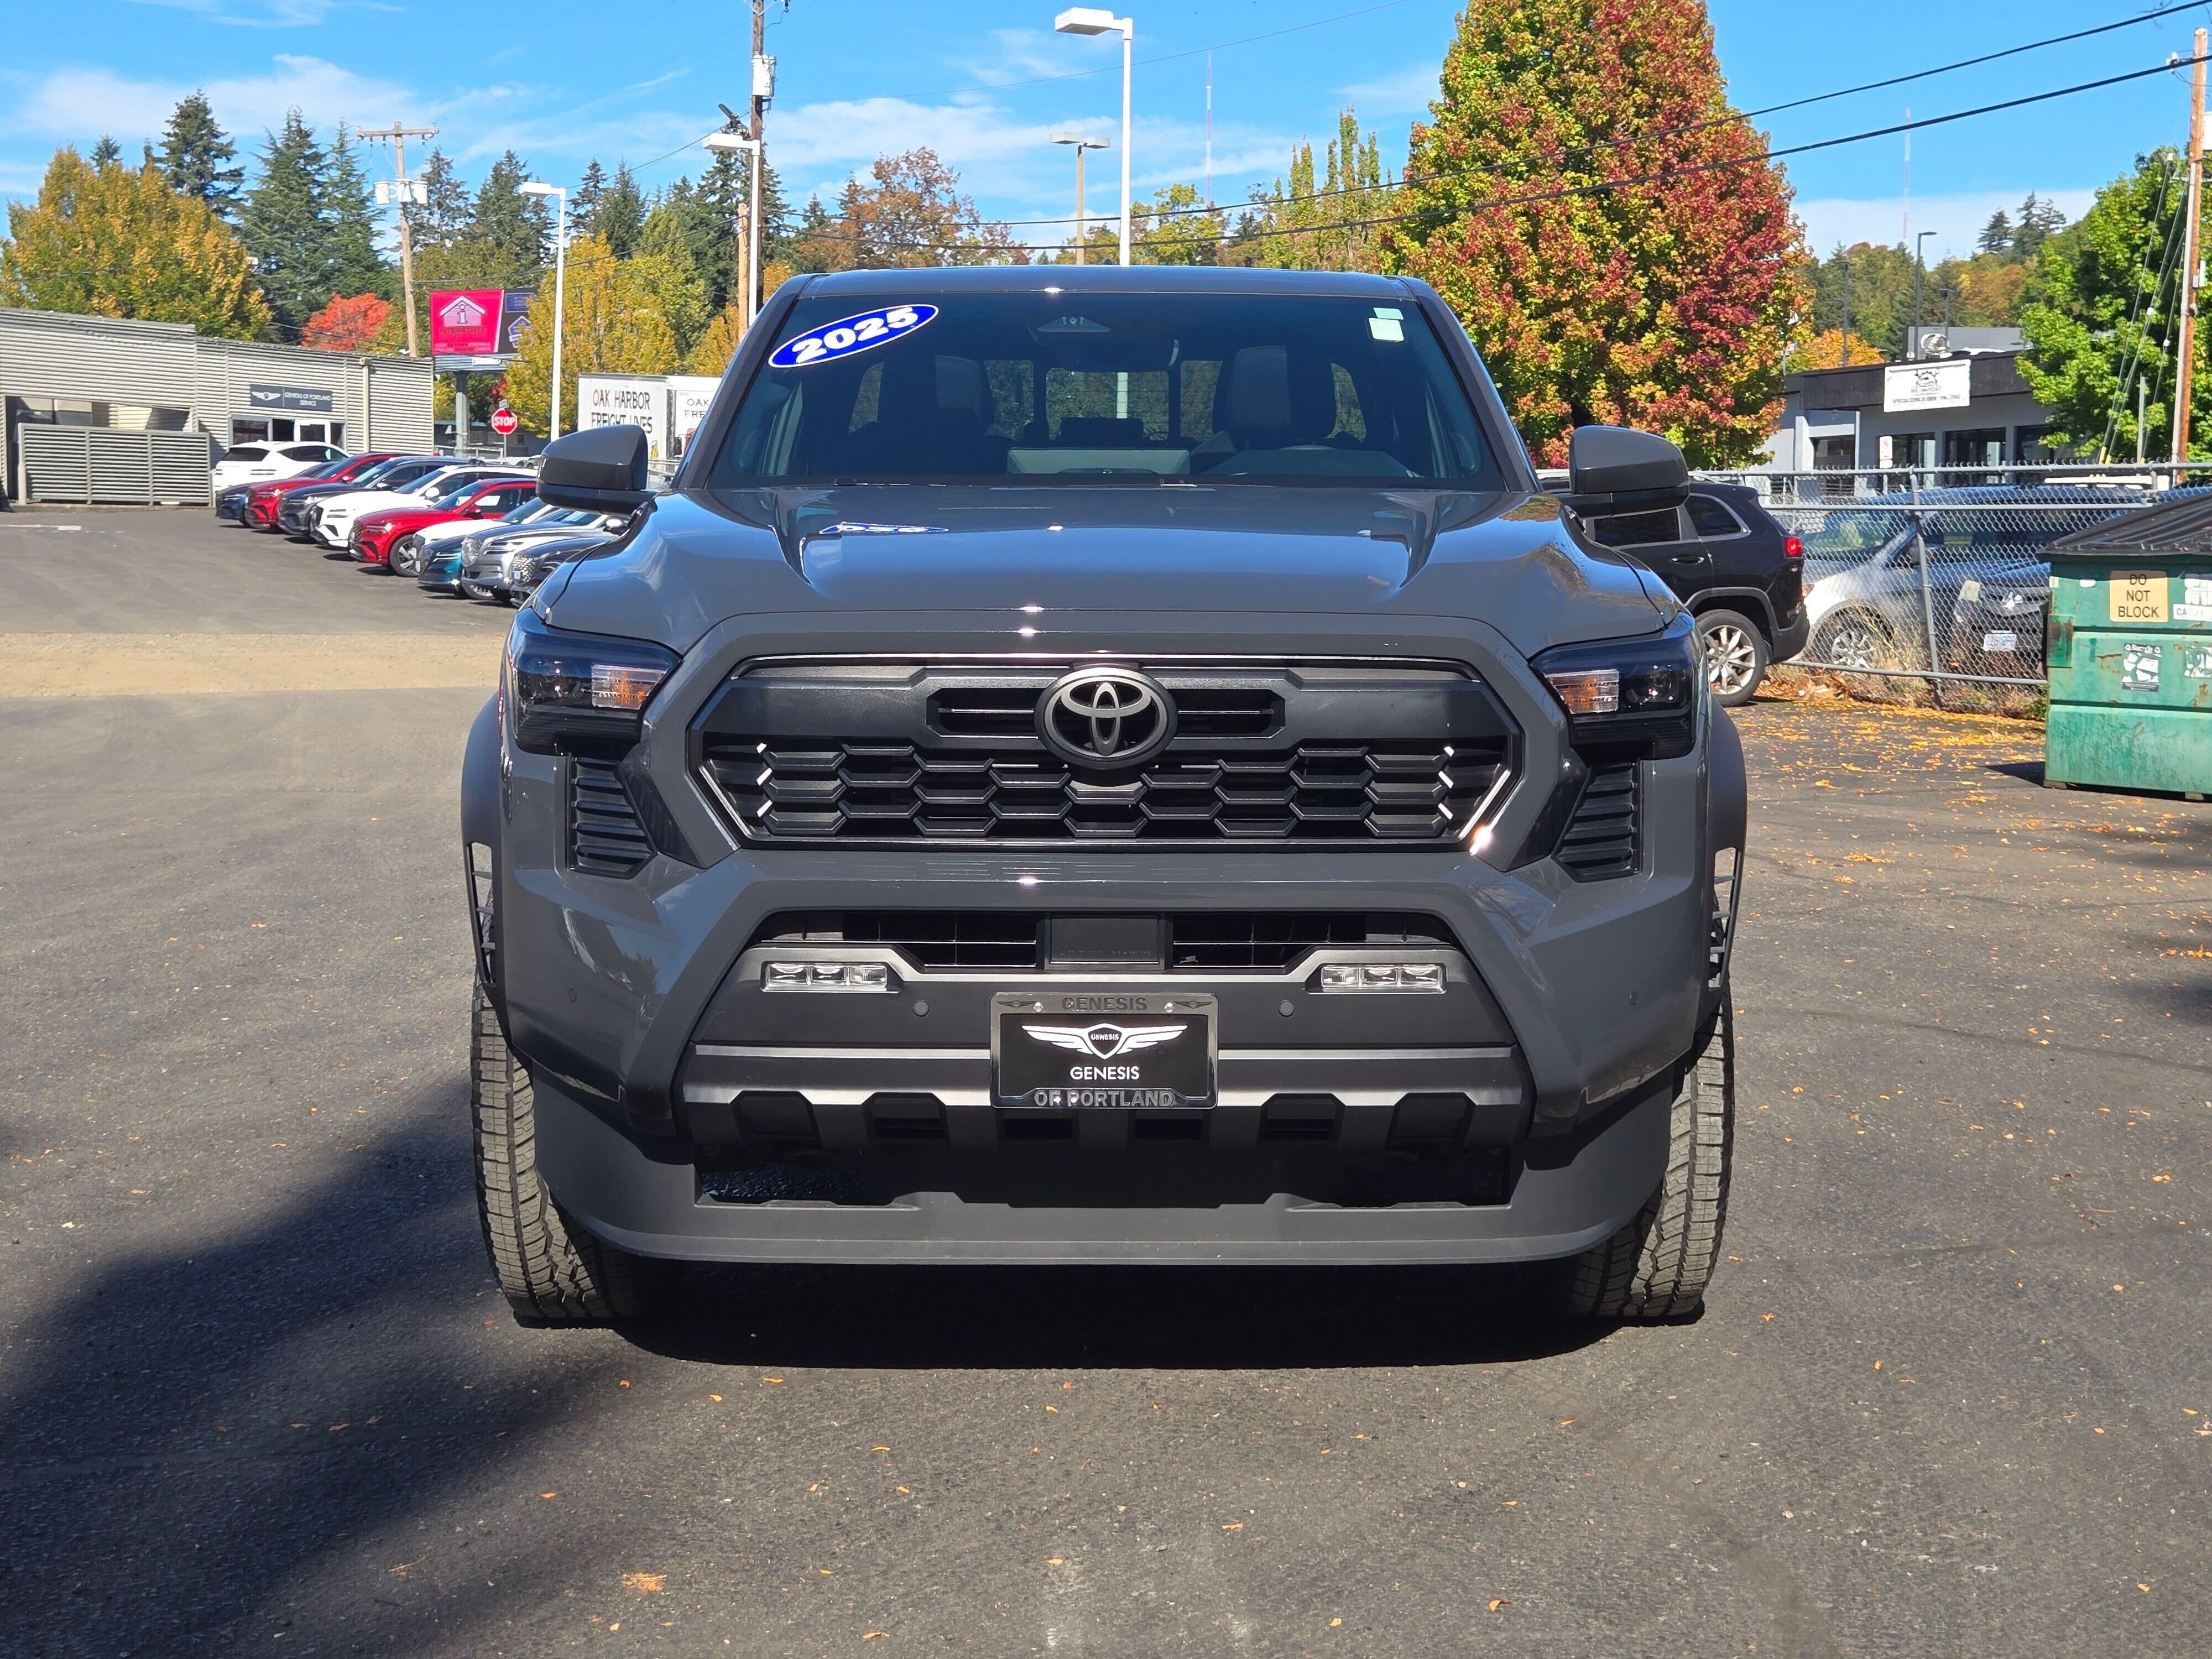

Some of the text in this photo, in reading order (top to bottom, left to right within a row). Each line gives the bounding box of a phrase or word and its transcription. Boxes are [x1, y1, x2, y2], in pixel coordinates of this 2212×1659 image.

[791, 306, 919, 364] 2025
[593, 389, 650, 410] OAK HARBOR
[494, 416, 515, 426] STOP
[2130, 574, 2147, 585] DO
[2126, 590, 2151, 602] NOT
[2119, 606, 2159, 618] BLOCK
[1061, 997, 1147, 1012] GENESIS
[1070, 1066, 1140, 1081] GENESIS
[1034, 1090, 1175, 1107] OF PORTLAND
